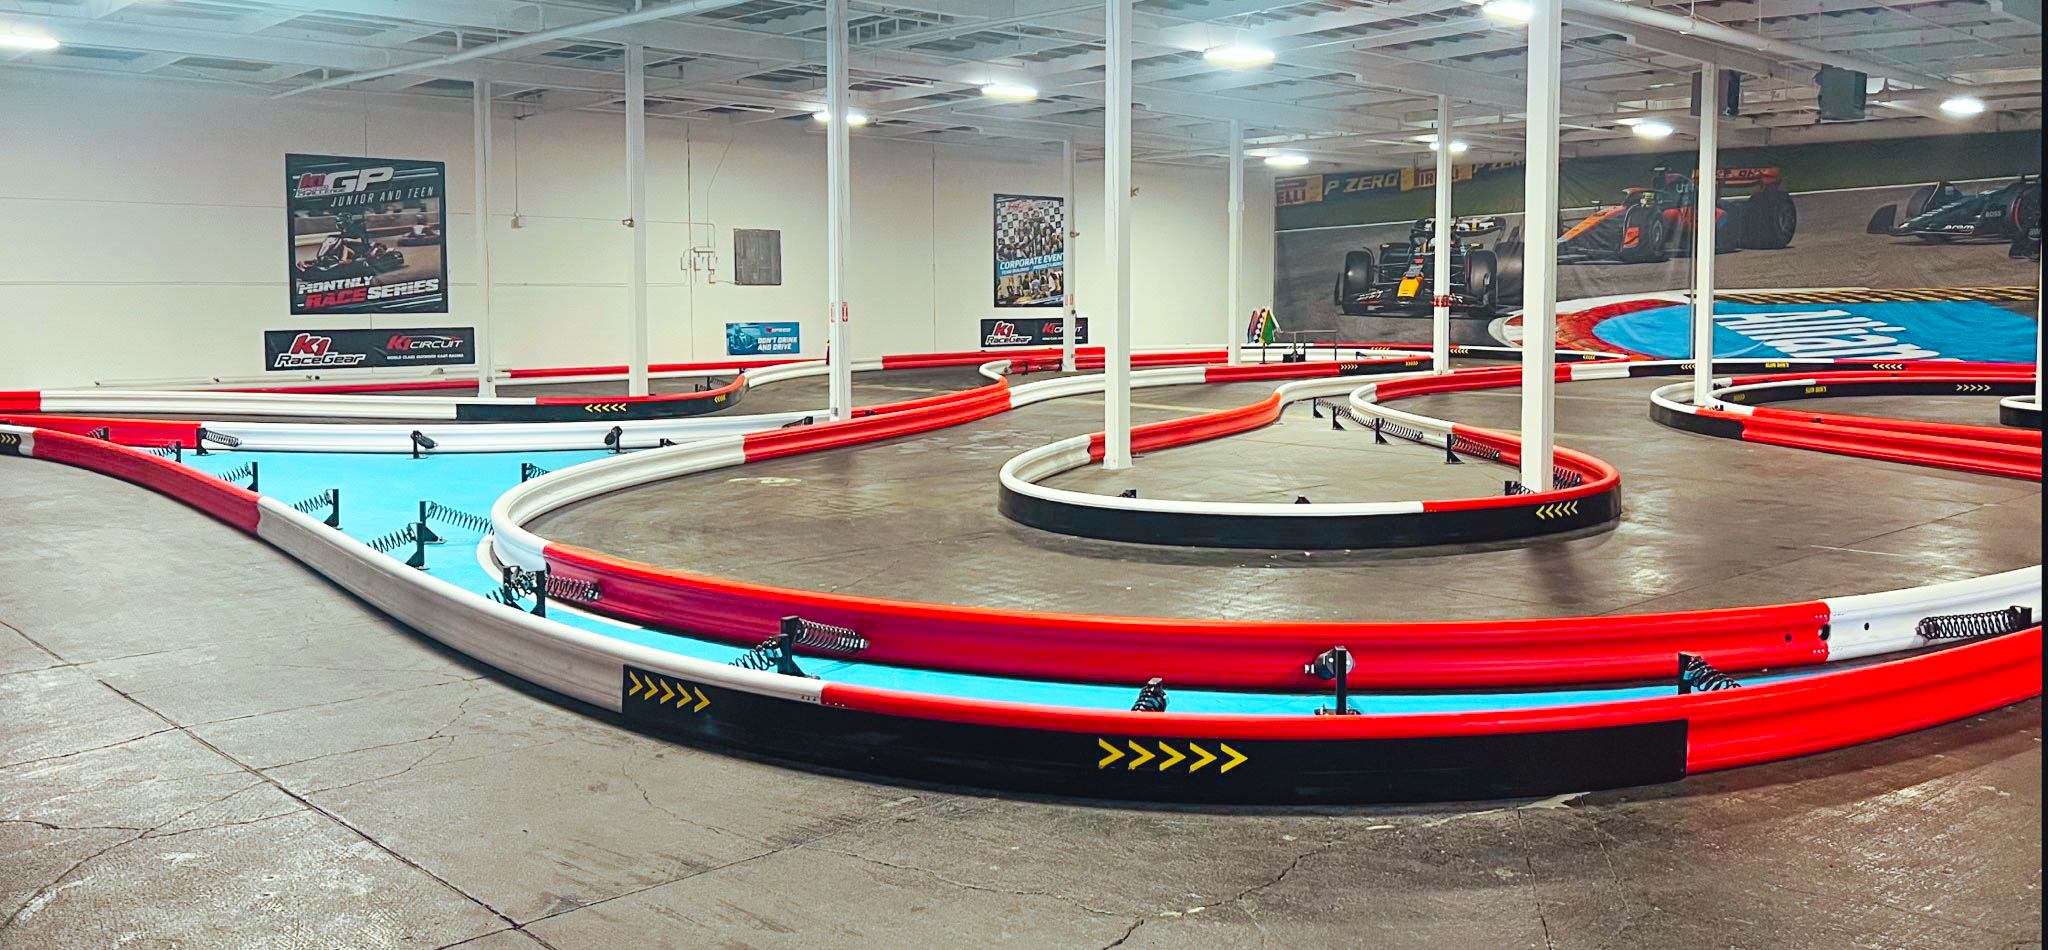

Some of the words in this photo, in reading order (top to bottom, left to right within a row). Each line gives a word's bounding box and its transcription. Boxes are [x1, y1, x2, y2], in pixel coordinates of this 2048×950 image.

[324, 167, 394, 193] GP
[1324, 182, 1338, 195] P
[1344, 173, 1398, 193] ZERO
[331, 193, 373, 207] JUNIOR
[379, 190, 402, 201] AND
[408, 186, 434, 199] TEEN
[1000, 256, 1043, 270] CORPORATE
[298, 275, 374, 294] MONTHLY
[304, 287, 368, 310] RACE
[367, 278, 440, 300] SERIES
[992, 321, 1014, 337] K1
[1713, 309, 1946, 361] Allian
[290, 334, 331, 356] K1
[386, 335, 411, 351] K1
[410, 340, 464, 349] CIRCUIT
[985, 335, 1032, 345] RaceGear
[275, 354, 366, 367] RaceGear
